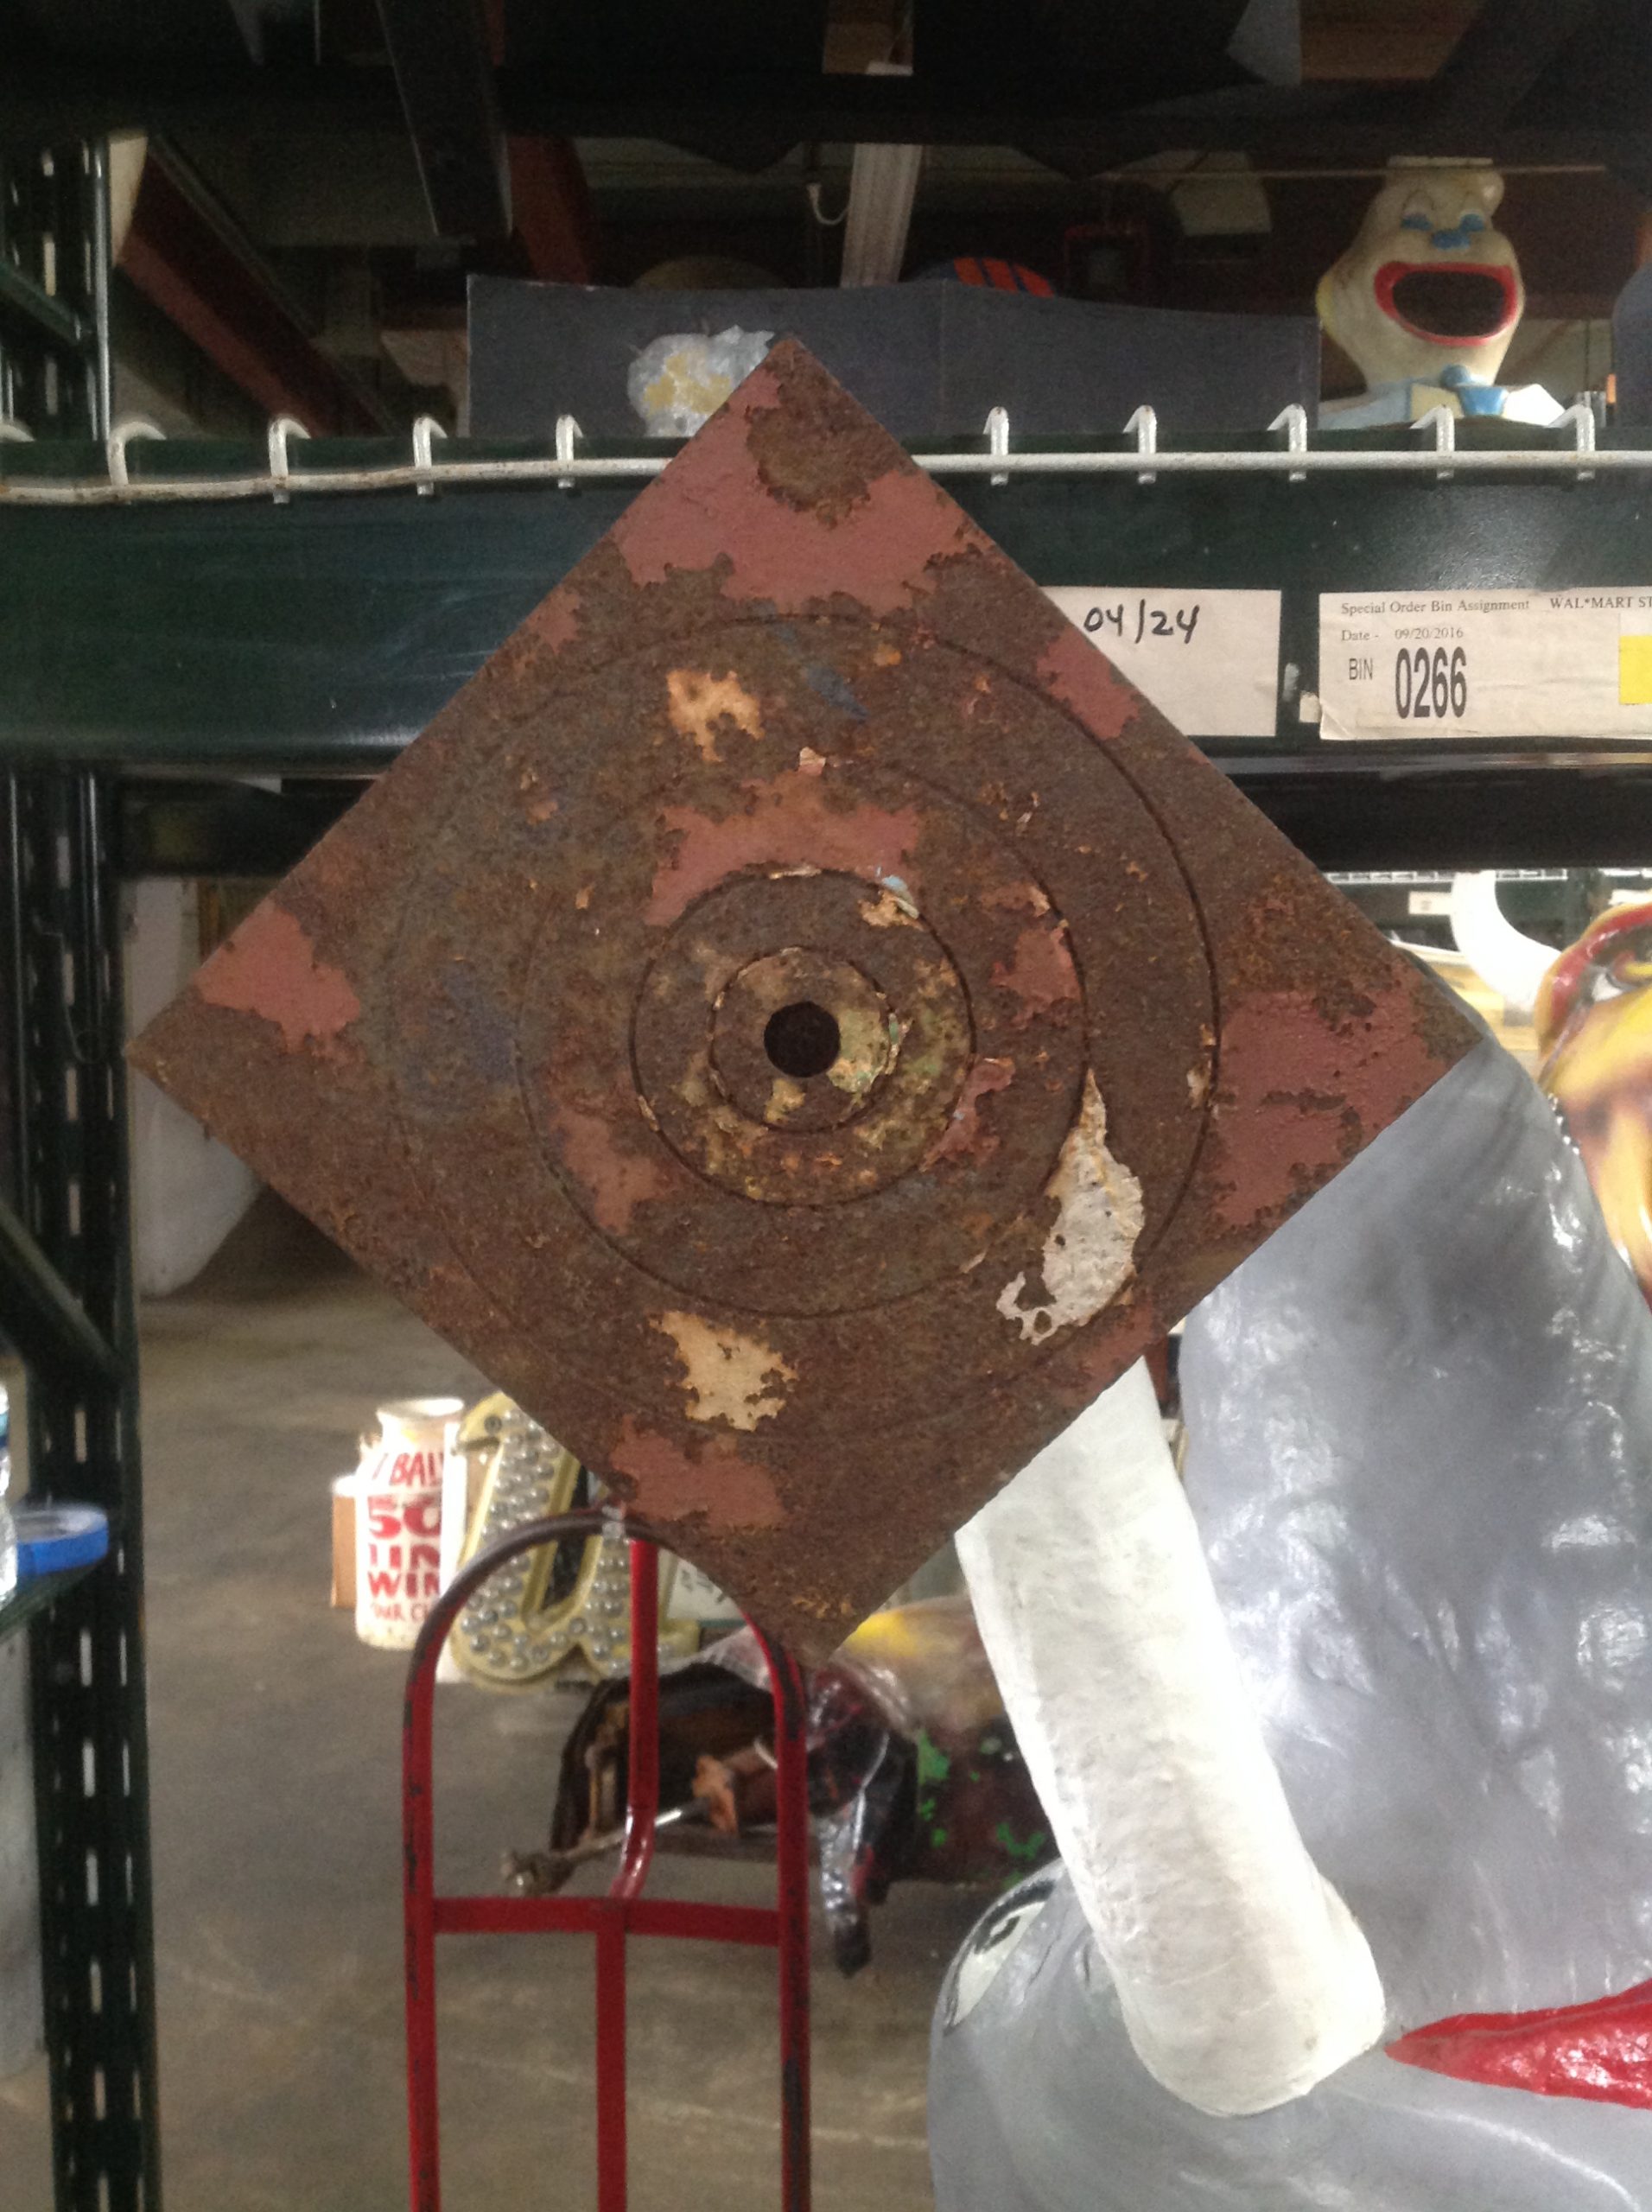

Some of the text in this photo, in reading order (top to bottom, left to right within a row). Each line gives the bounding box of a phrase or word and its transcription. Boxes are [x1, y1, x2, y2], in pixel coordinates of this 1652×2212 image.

[1341, 600, 1529, 616] Special Order Bin Assignment
[1083, 598, 1200, 644] 04/24
[1341, 629, 1370, 641] Date
[1395, 627, 1464, 639] 09/20/2016
[1349, 658, 1374, 681] BIN
[1395, 646, 1467, 719] 0266
